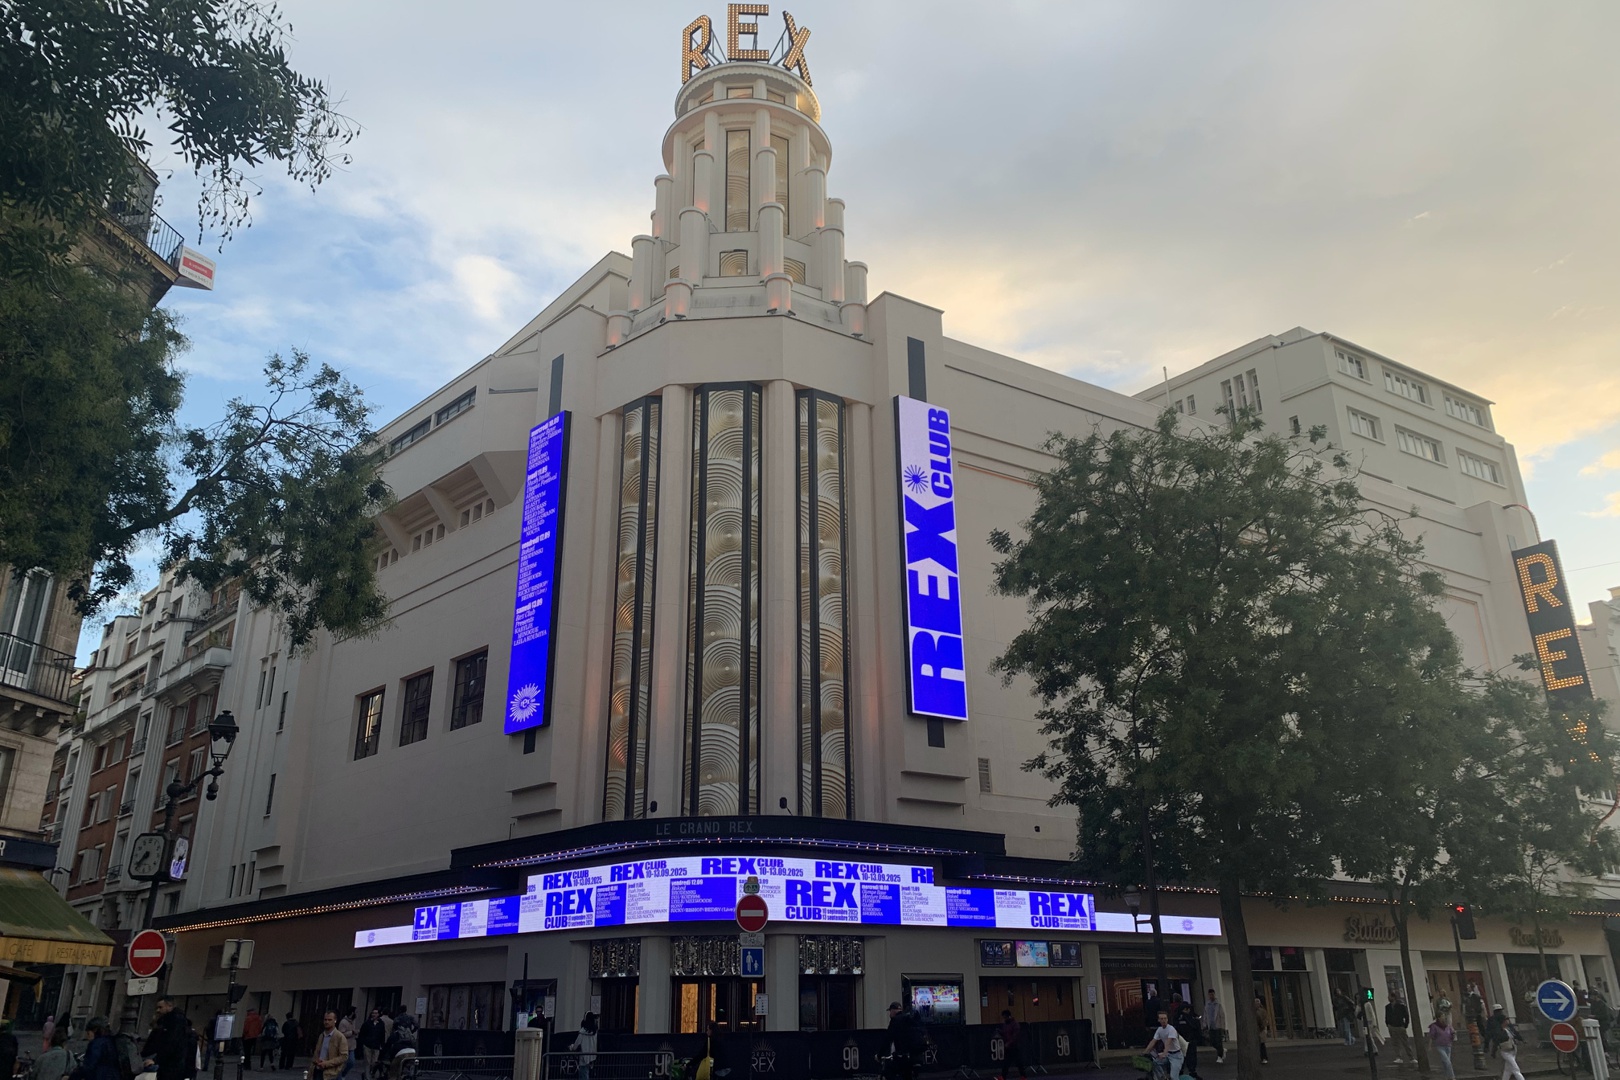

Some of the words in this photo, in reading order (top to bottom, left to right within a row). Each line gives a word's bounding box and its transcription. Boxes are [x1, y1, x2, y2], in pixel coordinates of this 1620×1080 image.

[682, 3, 813, 86] REX
[928, 407, 953, 500] CLUB
[904, 493, 968, 720] REX
[656, 823, 671, 836] LE
[680, 821, 720, 834] GRAND
[729, 821, 753, 833] REX
[610, 862, 645, 882] REX
[644, 860, 668, 870] CLUB
[645, 867, 688, 878] 10-13.09.2025
[701, 858, 758, 875] REX
[757, 858, 784, 868] CLUB
[759, 867, 804, 878] 10-13.09.2025
[815, 861, 861, 880] REX
[860, 864, 883, 874] CLUB
[543, 873, 573, 890] REX
[572, 870, 590, 879] CLUB
[861, 872, 901, 883] 10-13.09.2025
[545, 888, 594, 917] REX
[785, 879, 859, 908] REX
[785, 906, 823, 920] CLUB
[1029, 892, 1088, 917] REX
[544, 916, 568, 929] CLUB
[1030, 915, 1060, 928] CLUB
[56, 947, 103, 961] RESTAURANT
[751, 1057, 776, 1073] REX
[843, 1047, 860, 1070] 90
